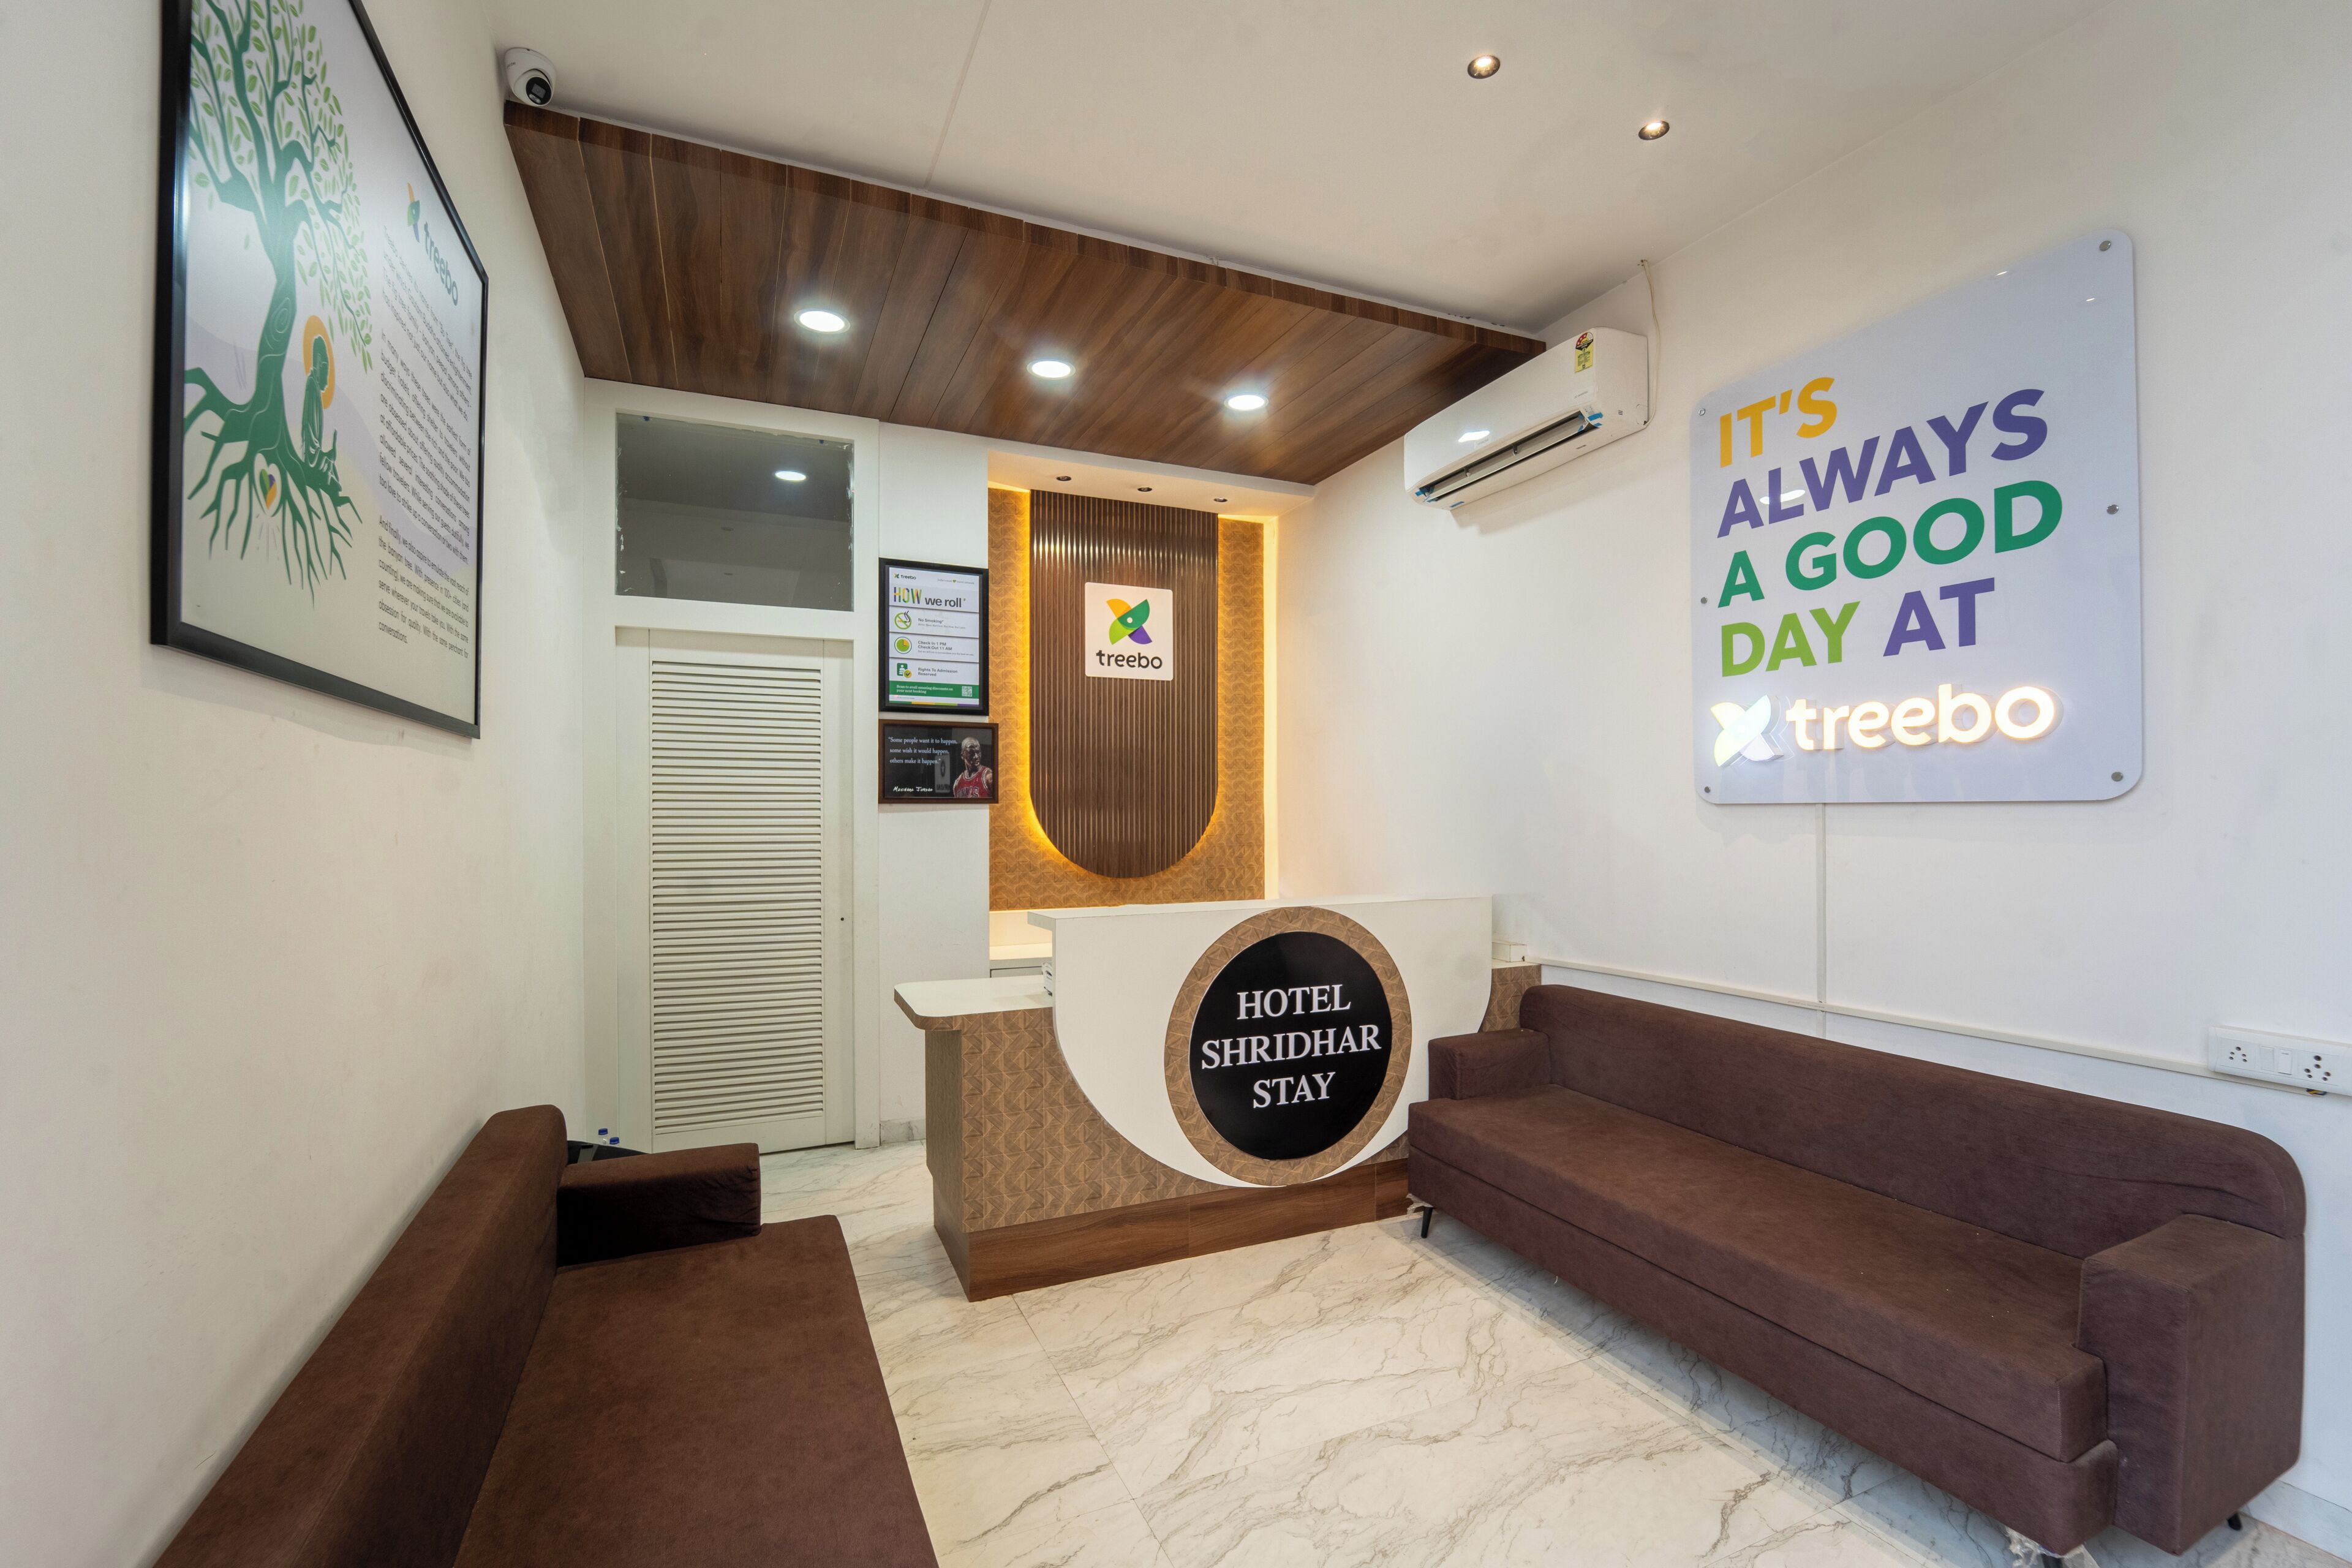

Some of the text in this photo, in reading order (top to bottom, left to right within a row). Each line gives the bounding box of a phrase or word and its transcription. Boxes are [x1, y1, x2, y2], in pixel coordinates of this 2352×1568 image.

[424, 222, 458, 306] treebo
[1717, 388, 2048, 538] ALWAYS
[1717, 480, 2063, 608] A GOOD
[894, 587, 922, 604] HOW
[925, 597, 942, 606] we
[1721, 577, 1995, 677] DAY AT
[1096, 650, 1163, 669] treebo
[1785, 684, 2058, 752] treebo
[1237, 984, 1351, 1020] HOTEL
[1202, 1024, 1382, 1070] SHRIDHAR
[1253, 1072, 1336, 1109] STAY
